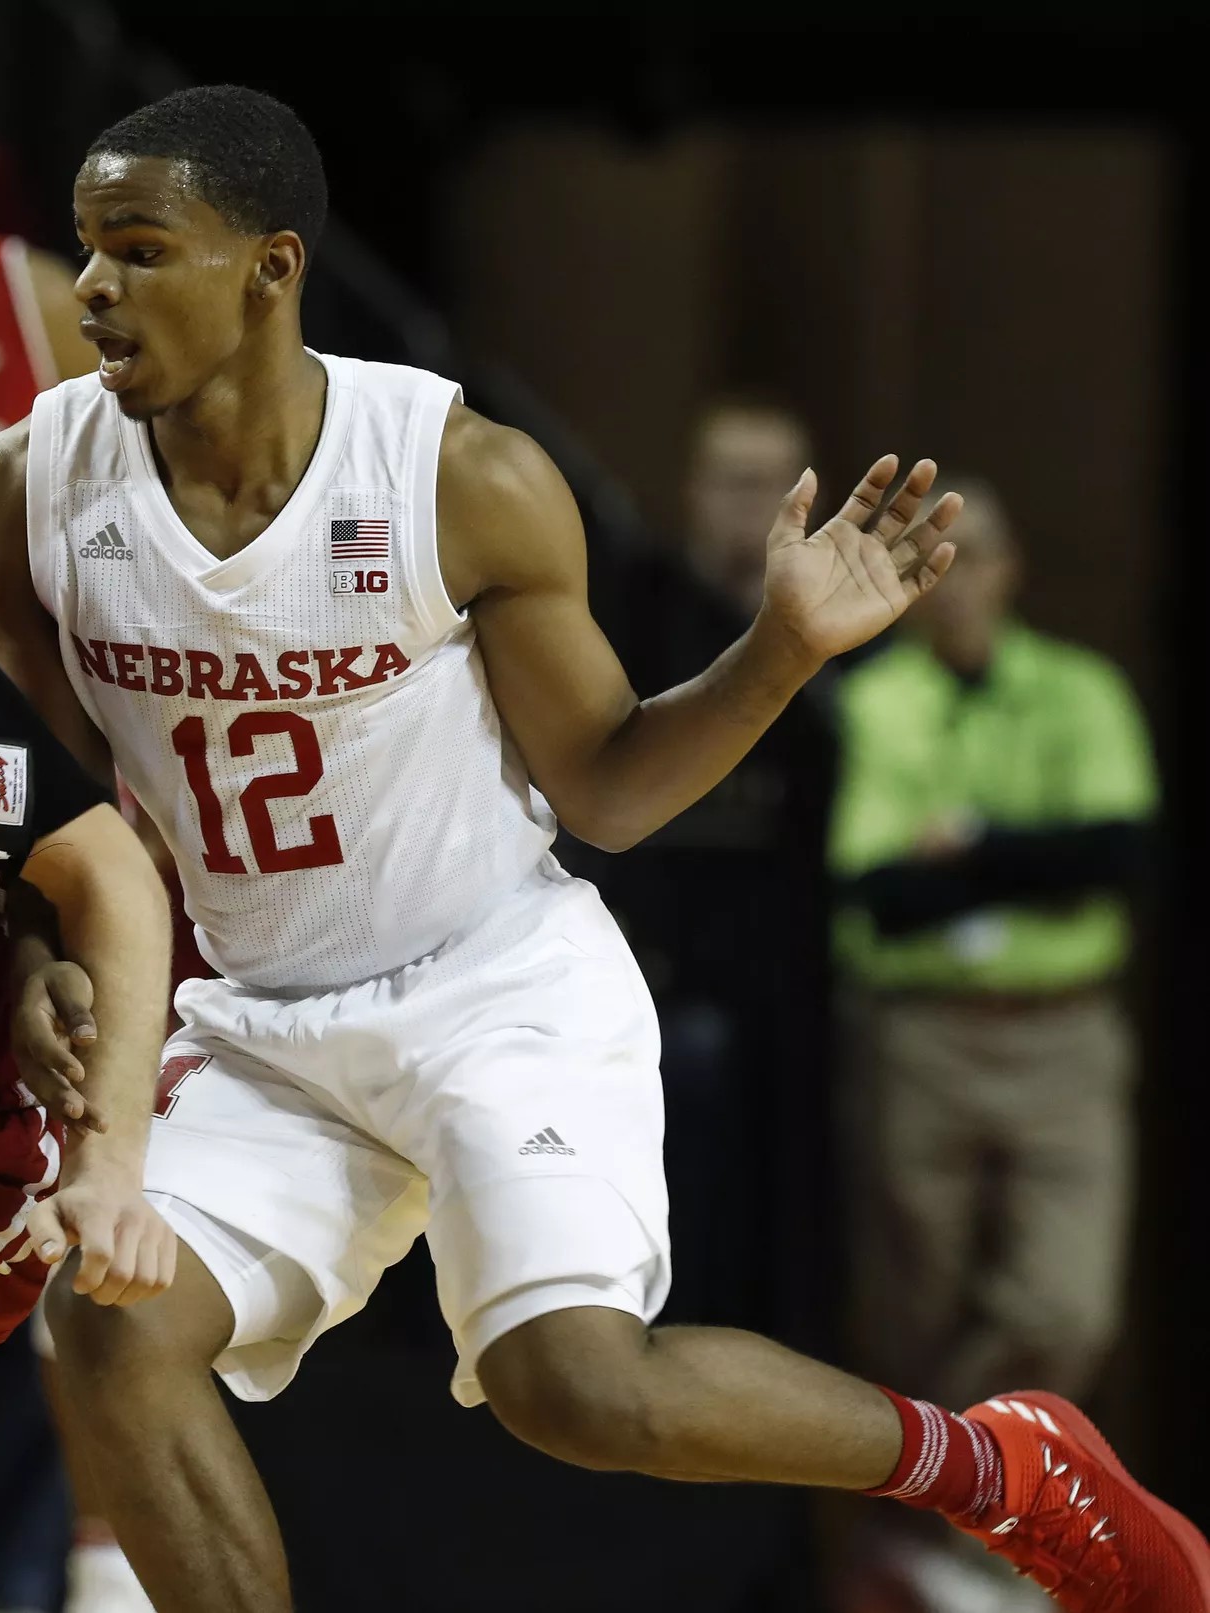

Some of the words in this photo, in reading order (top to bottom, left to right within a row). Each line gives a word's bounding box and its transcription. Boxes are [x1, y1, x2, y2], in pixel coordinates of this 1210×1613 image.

[80, 545, 134, 561] adidas
[71, 631, 411, 701] NEBRASKA
[171, 711, 344, 874] 12
